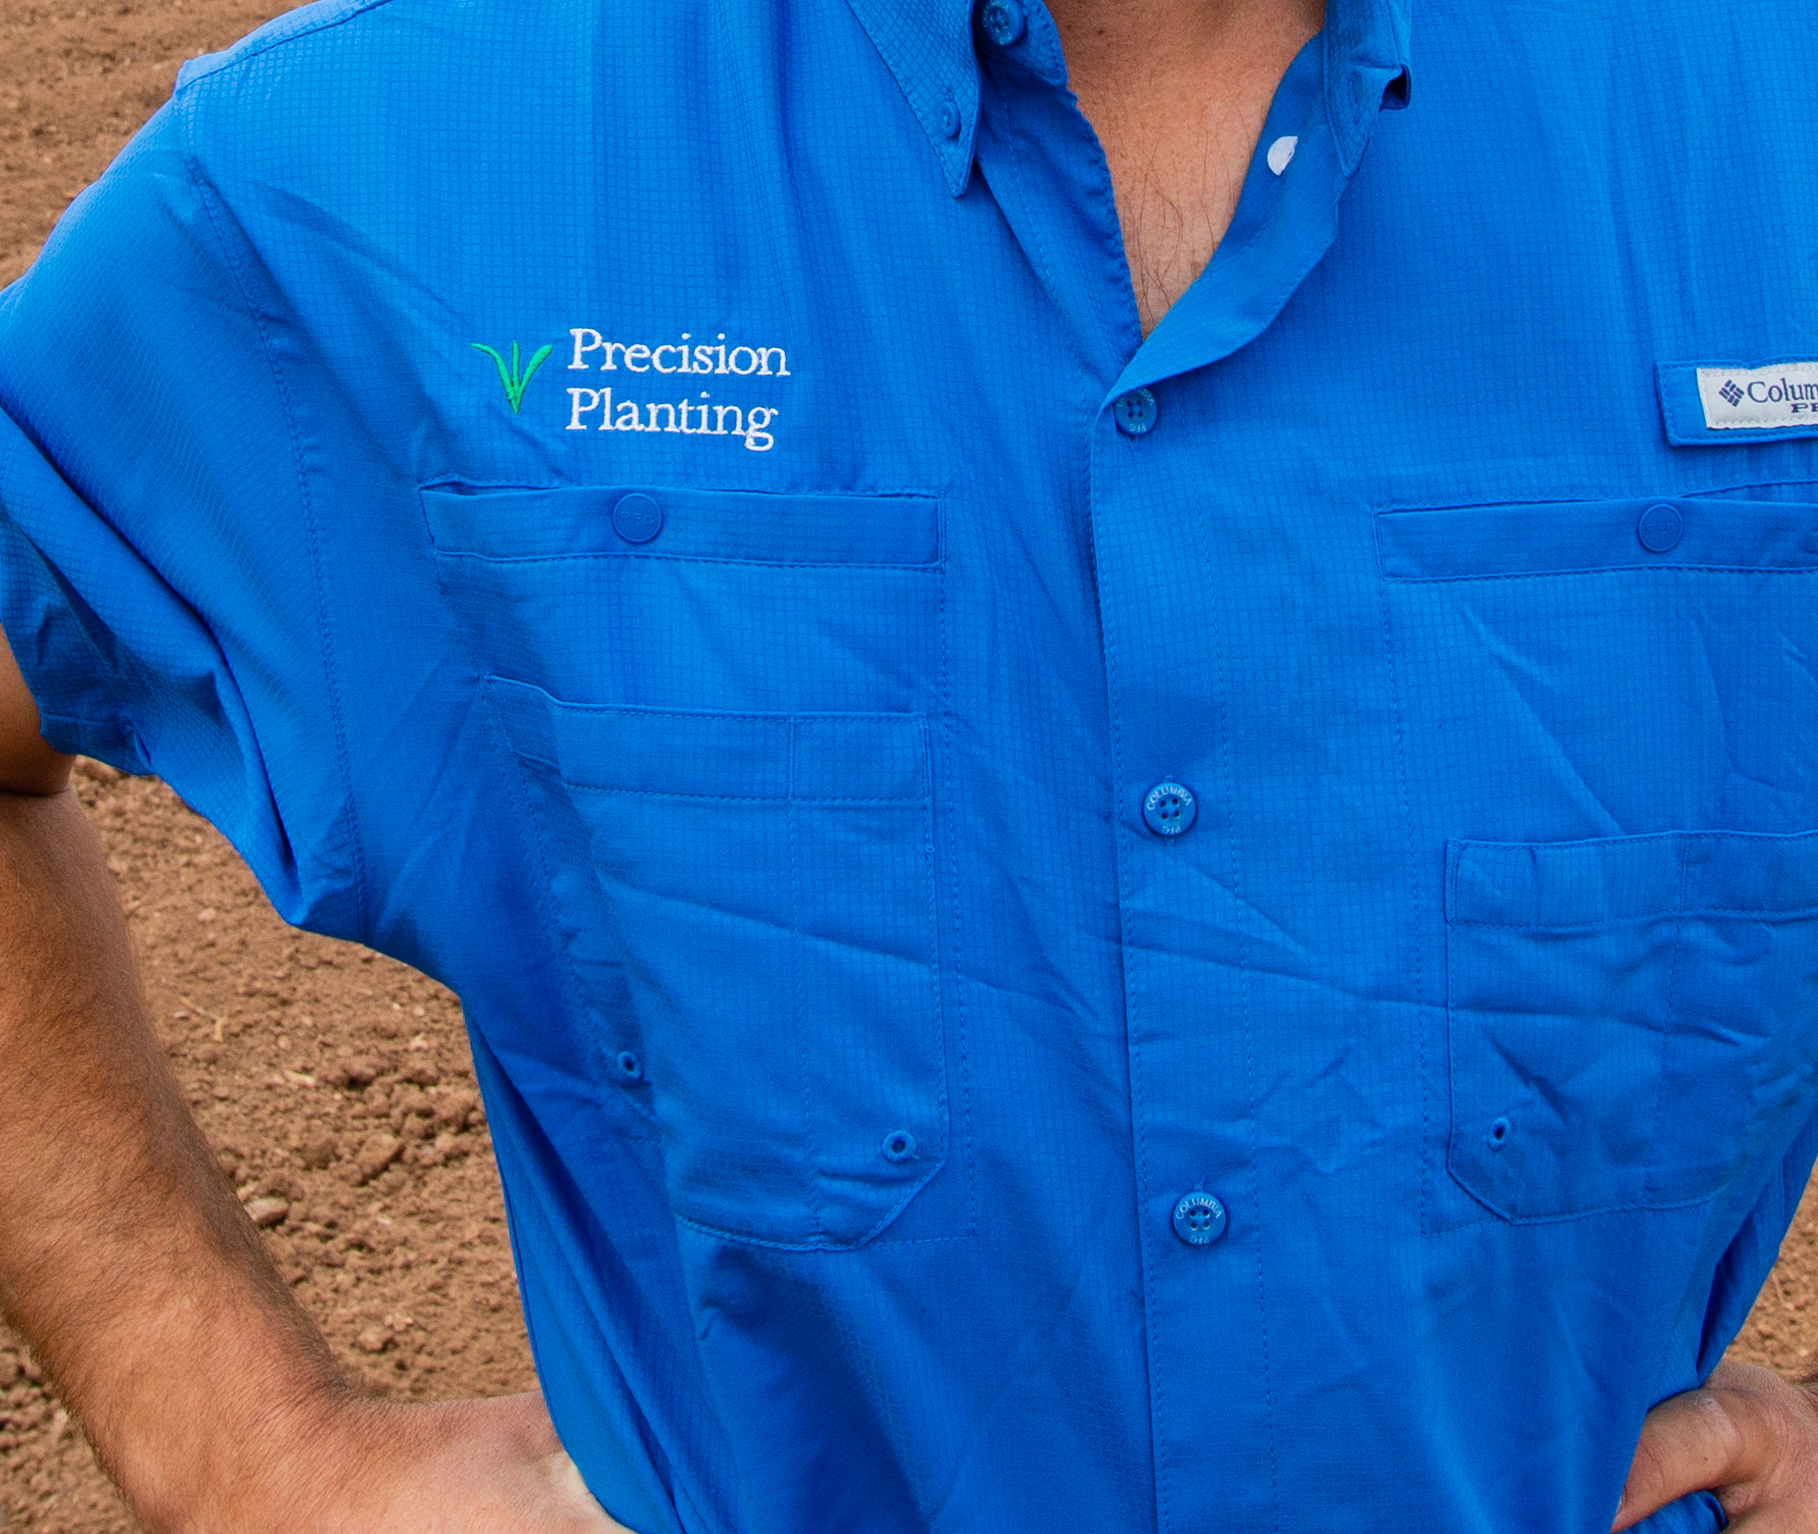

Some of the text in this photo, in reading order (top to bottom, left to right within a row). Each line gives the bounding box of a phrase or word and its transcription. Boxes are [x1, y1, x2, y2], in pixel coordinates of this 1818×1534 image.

[567, 327, 792, 377] Precision
[565, 386, 780, 452] Planting
[1146, 785, 1193, 811] COLUMBIA
[1175, 1196, 1223, 1220] COLUMBIA
